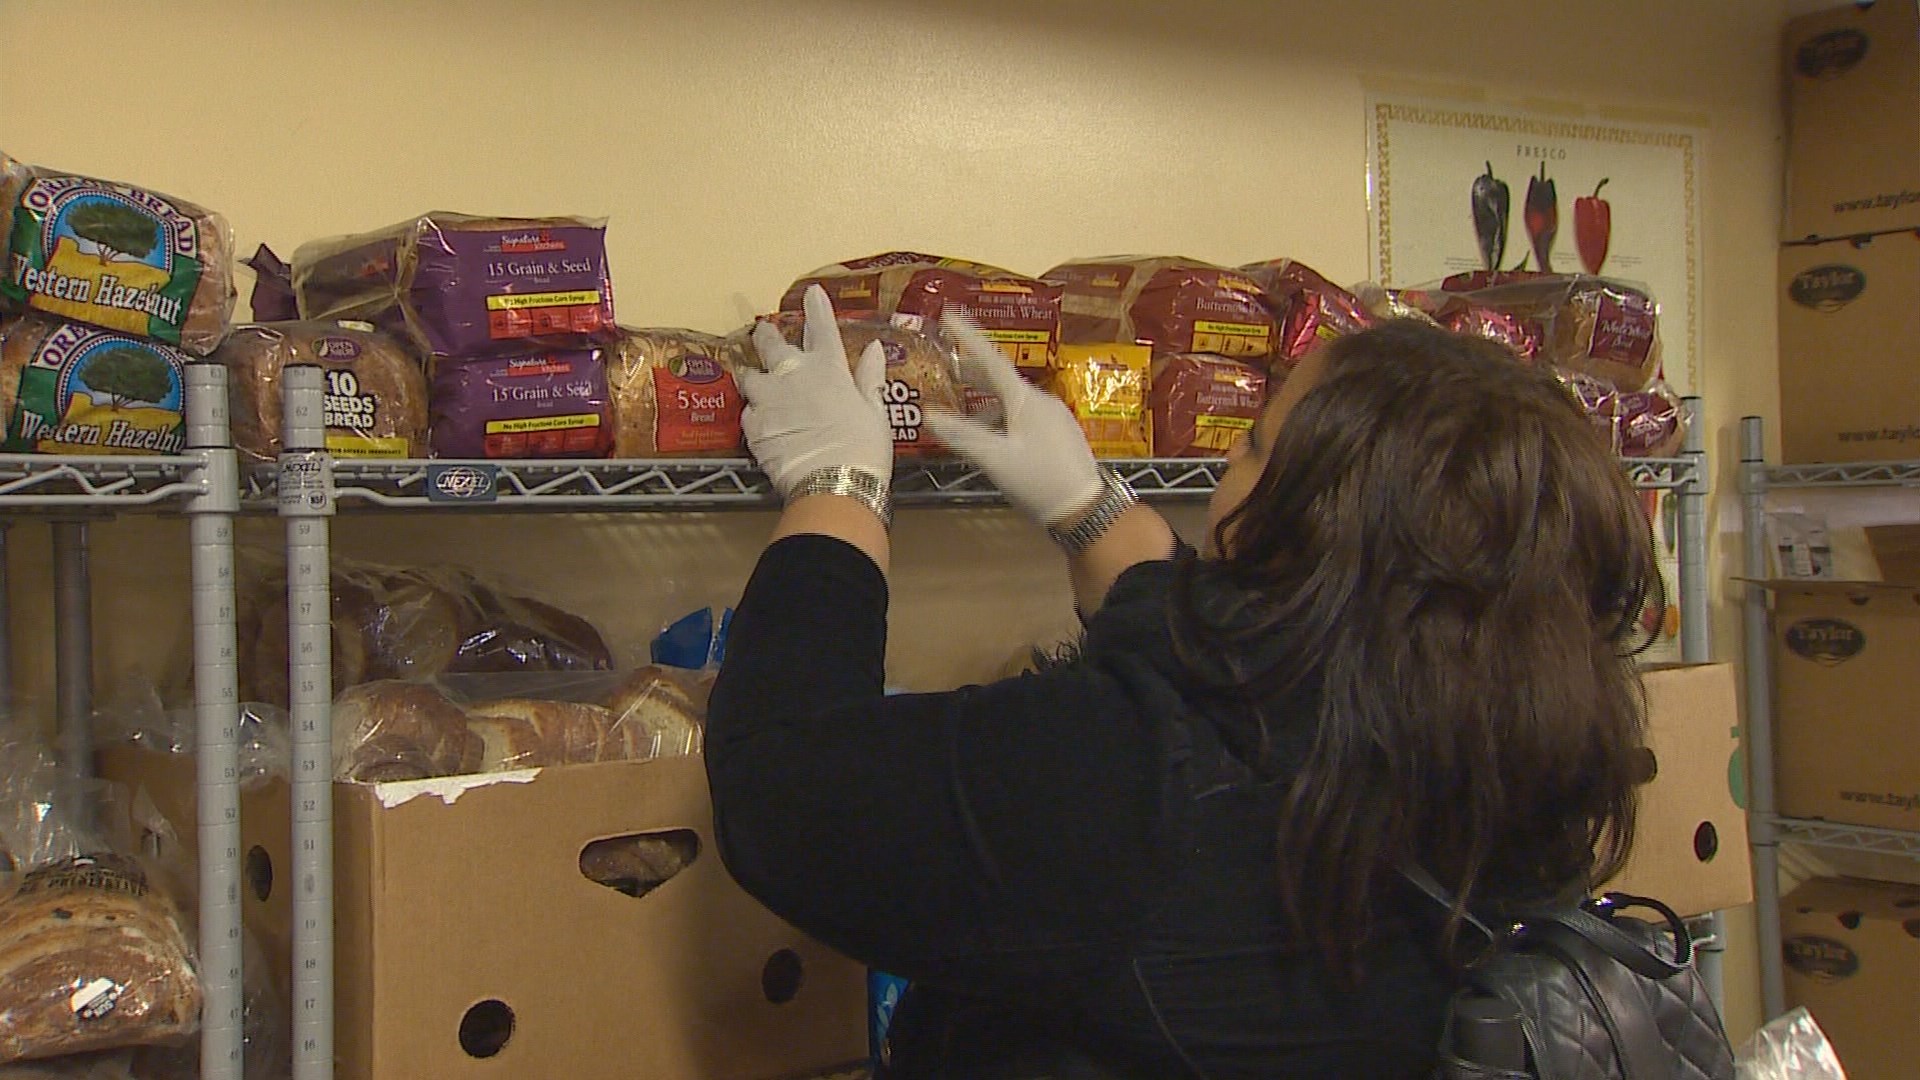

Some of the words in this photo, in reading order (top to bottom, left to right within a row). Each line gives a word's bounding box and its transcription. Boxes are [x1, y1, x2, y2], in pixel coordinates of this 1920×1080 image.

[1516, 144, 1567, 160] FRESCO
[488, 262, 504, 277] 15
[508, 260, 544, 276] Grain
[547, 262, 559, 274] &
[562, 257, 592, 273] Seed
[95, 273, 182, 326] Hazelnut
[960, 303, 1016, 319] Buttermilk
[1020, 304, 1052, 321] Wheat
[327, 371, 358, 397] 10
[492, 388, 508, 402] 15
[512, 384, 549, 401] Grain
[552, 386, 563, 398] &
[882, 381, 918, 402] RO-
[324, 395, 375, 413] SEEDS
[677, 389, 690, 409] 5
[691, 390, 726, 409] Seed
[296, 405, 309, 417] 62
[324, 411, 375, 428] BREAD
[690, 411, 715, 422] Bread
[20, 409, 100, 446] Western
[104, 420, 187, 453] Hazelnu
[892, 427, 918, 441] EAD
[442, 474, 487, 488] NEXEL
[300, 603, 312, 614] 57
[303, 800, 315, 811] 52
